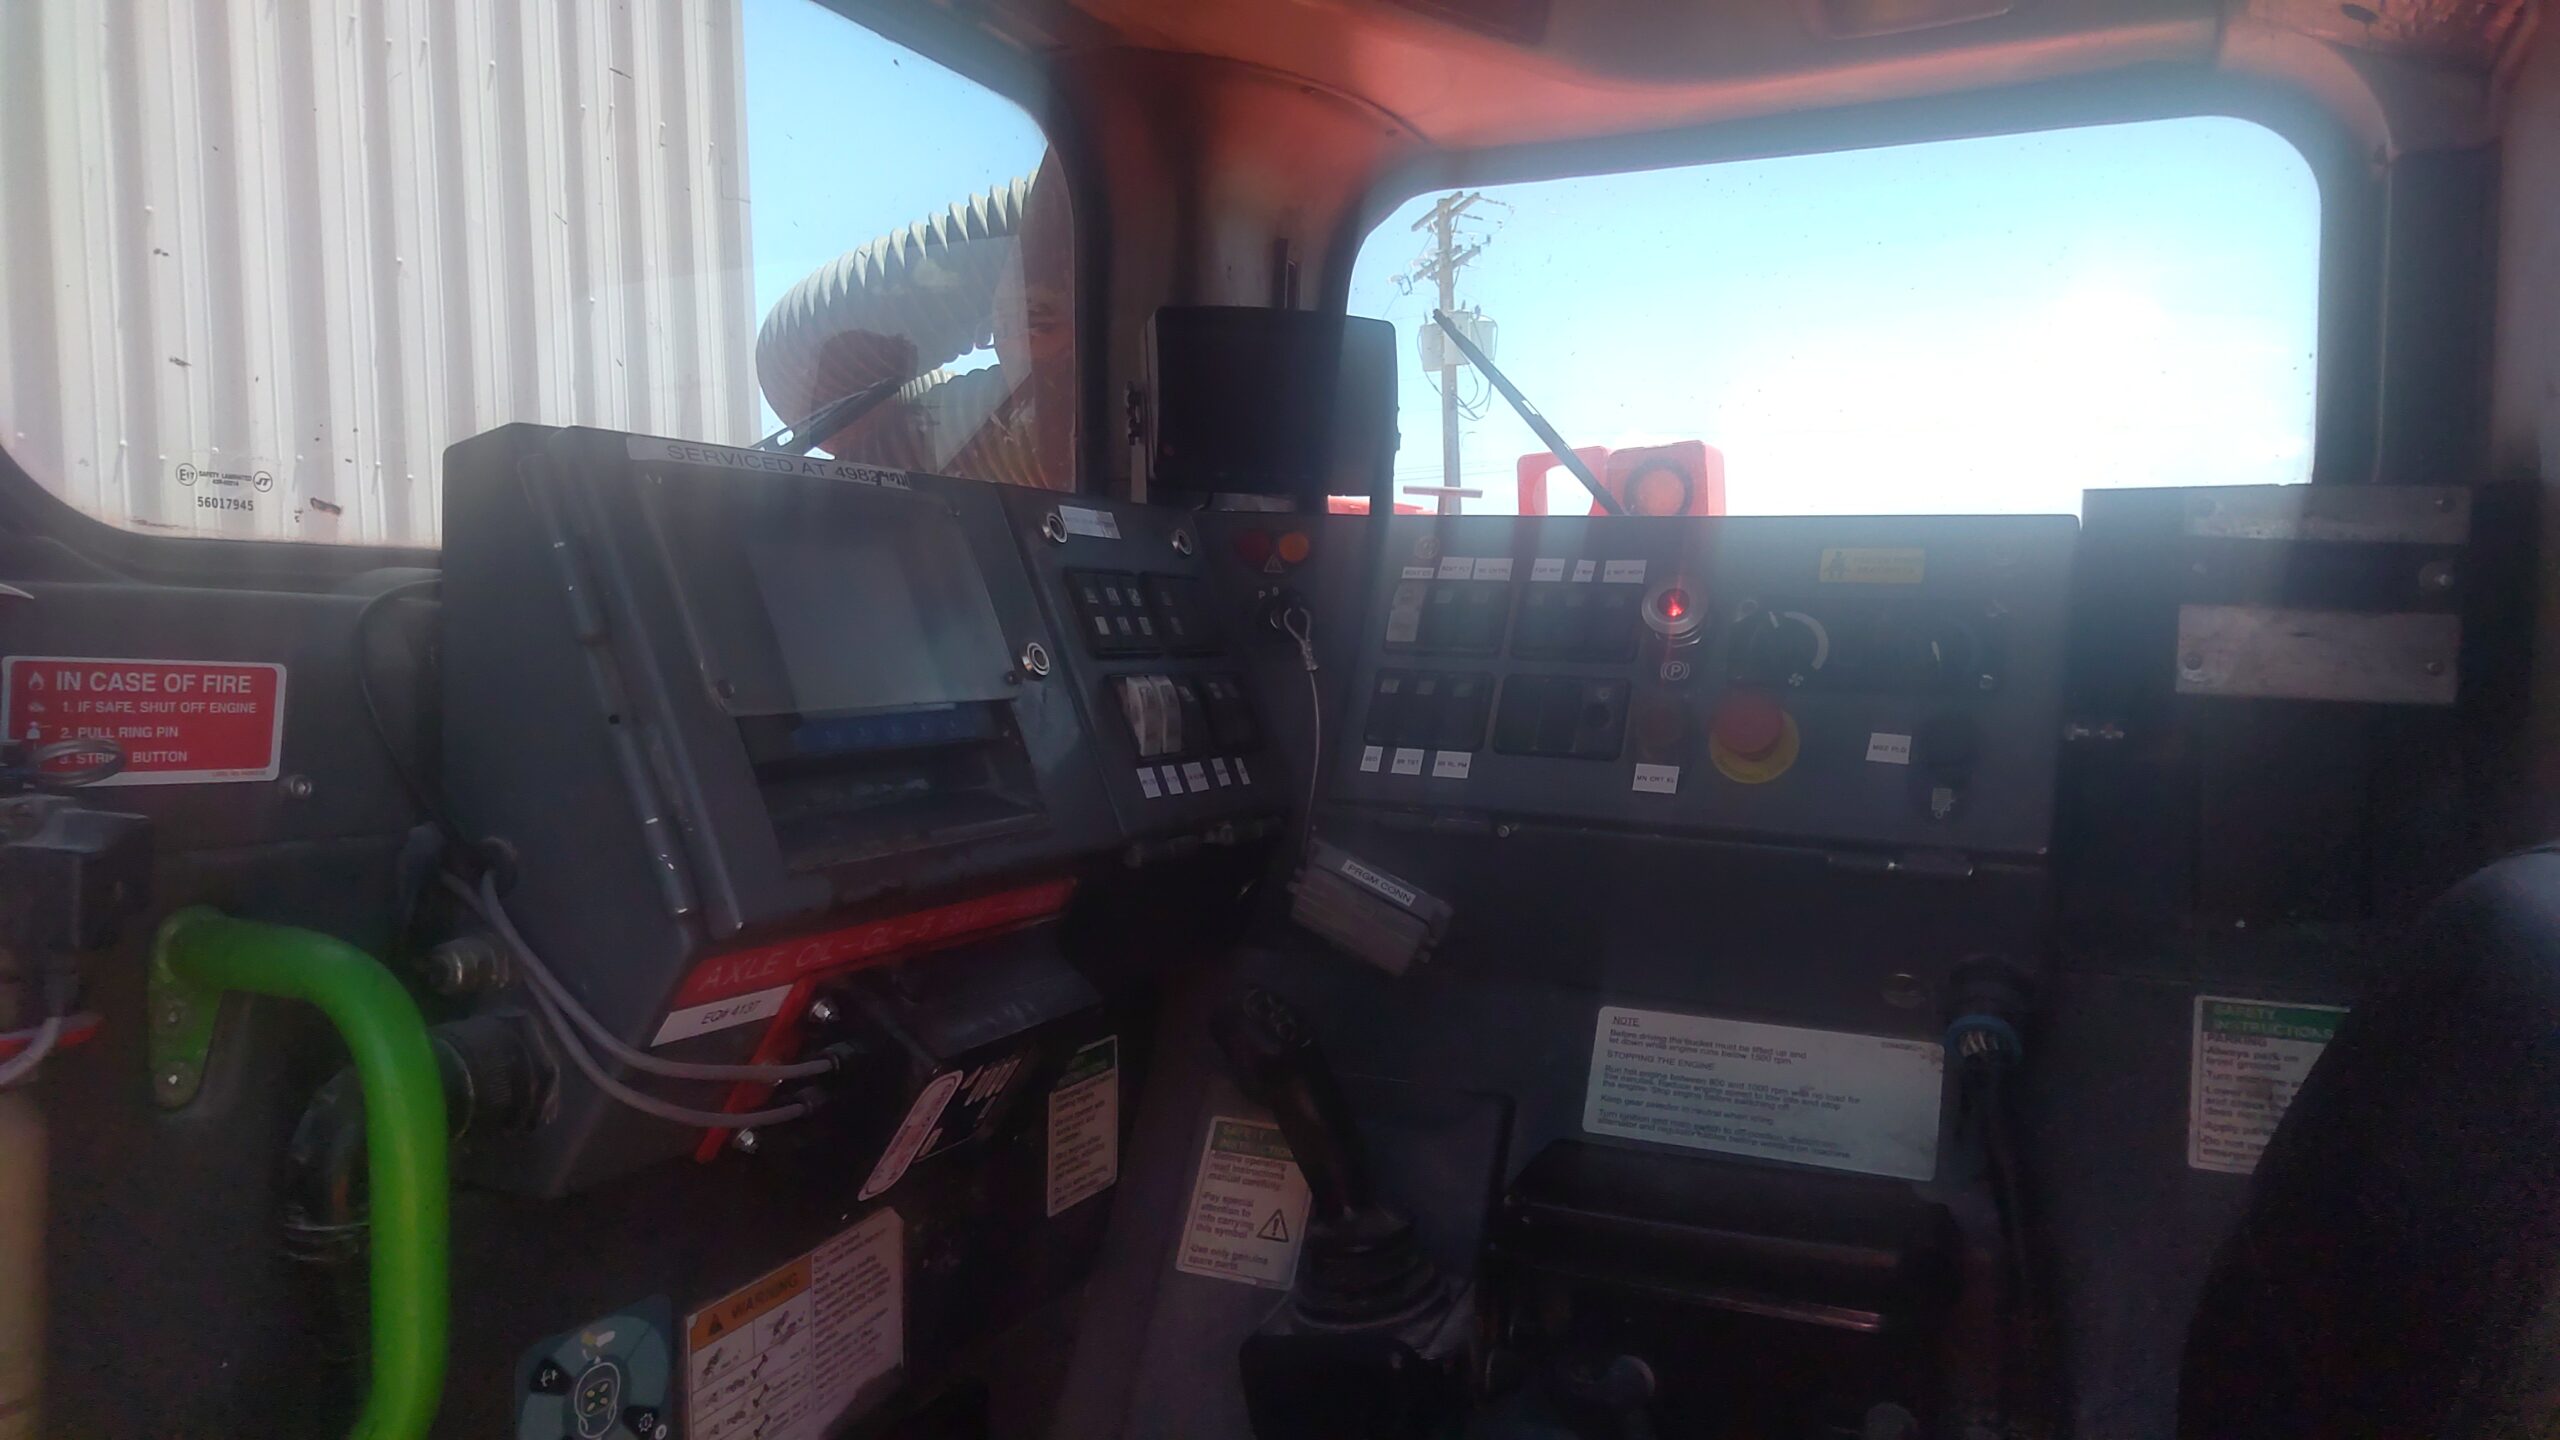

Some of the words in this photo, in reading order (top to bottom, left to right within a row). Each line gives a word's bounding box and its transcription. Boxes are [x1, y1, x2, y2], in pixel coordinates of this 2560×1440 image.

[667, 444, 793, 473] SERVICED
[801, 461, 826, 477] AT
[197, 496, 254, 511] 56017945
[56, 671, 80, 692] IN
[90, 672, 157, 693] CASE
[163, 673, 196, 694] OF
[202, 674, 252, 695] FIRE
[78, 702, 92, 713] IF
[140, 702, 177, 714] SHUT
[180, 702, 207, 714] OFF
[210, 702, 257, 715] ENGINE
[78, 727, 114, 739] PULL
[119, 726, 153, 739] RING
[156, 727, 179, 738] PIN
[132, 752, 188, 763] BUTTON
[1347, 863, 1379, 887] PRGM
[1380, 881, 1412, 903] CONN
[697, 950, 786, 992] AXLE
[2213, 1003, 2275, 1020] SAFETY
[1613, 1016, 1640, 1028] NOTE
[1611, 1029, 1638, 1040] Before
[1639, 1032, 1667, 1044] driving
[1683, 1036, 1713, 1048] bucket
[1715, 1040, 1737, 1050] must
[1776, 1049, 1788, 1059] up
[1790, 1051, 1807, 1059] and
[2206, 1032, 2268, 1047] PARKING
[1621, 1038, 1644, 1048] down
[1669, 1045, 1698, 1056] engine
[1721, 1049, 1747, 1060] below
[1751, 1053, 1772, 1063] 1500
[1607, 1050, 1655, 1063] STOPPING
[1658, 1055, 1674, 1066] THE
[1677, 1057, 1715, 1071] ENGINE
[1605, 1065, 1621, 1074] Run
[1600, 1108, 1618, 1118] Turn
[1241, 1207, 1252, 1217] to
